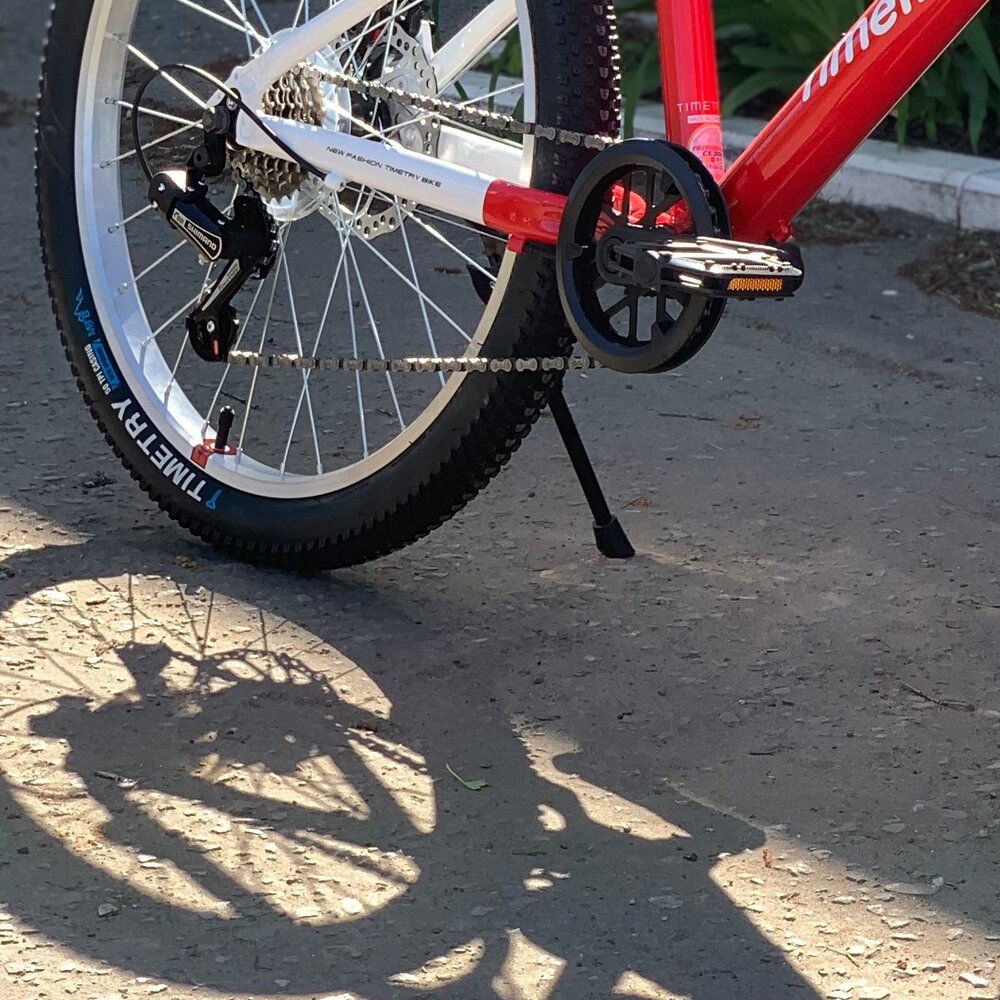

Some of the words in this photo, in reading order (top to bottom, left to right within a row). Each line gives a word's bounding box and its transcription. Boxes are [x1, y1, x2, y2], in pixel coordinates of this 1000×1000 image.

[326, 146, 345, 156] NEW
[346, 152, 383, 169] FASHION
[385, 164, 421, 180] TIMETRY
[421, 177, 442, 188] BIKE
[187, 223, 217, 251] SHIMANO
[84, 343, 101, 373] CASING
[95, 370, 107, 386] TPI
[102, 383, 112, 395] 50
[110, 398, 207, 502] TIMETRY
